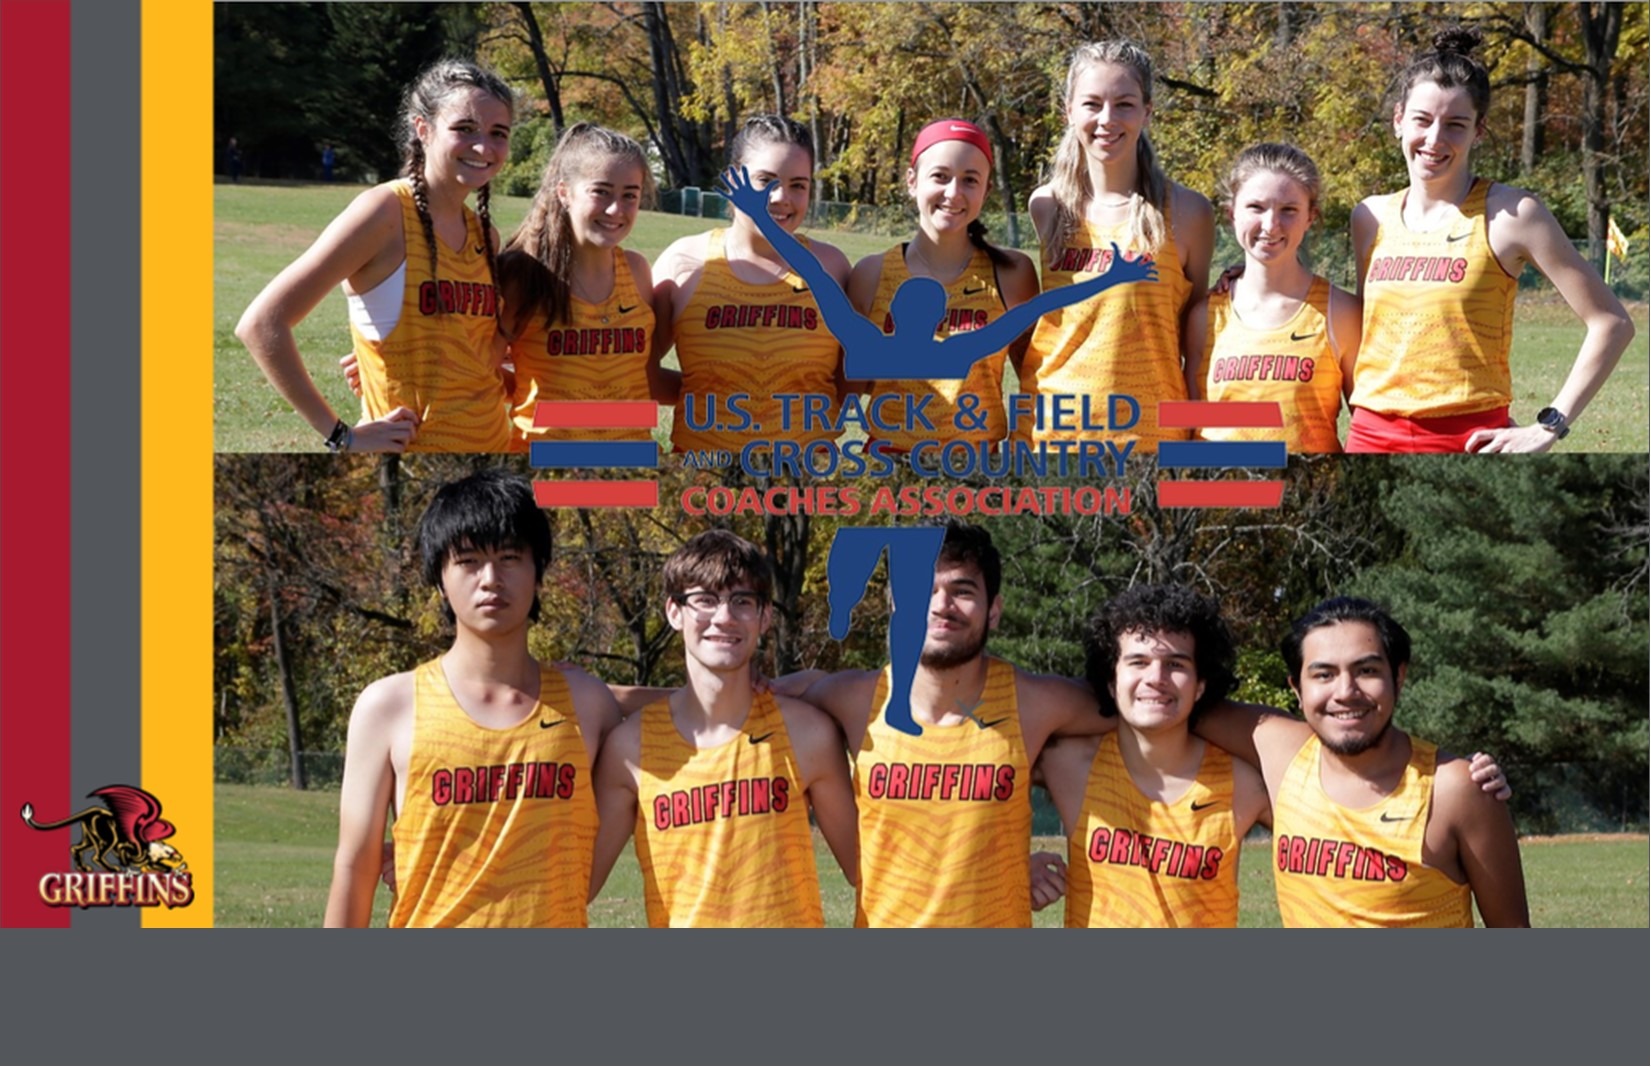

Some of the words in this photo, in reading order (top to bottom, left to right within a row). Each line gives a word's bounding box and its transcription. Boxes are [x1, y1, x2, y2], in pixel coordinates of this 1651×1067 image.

[1368, 256, 1468, 284] GRIFFINS
[705, 304, 818, 331] GRIFFINS
[547, 327, 646, 356] GRIFFINS
[1213, 355, 1315, 383] GRIFFINS
[432, 762, 576, 806] GRIFFINS
[868, 763, 1015, 801] GRIFFINS
[653, 776, 789, 832] GRIFFINS
[1088, 827, 1223, 880] GRIFFINS
[1277, 834, 1408, 882] GRIFFINS
